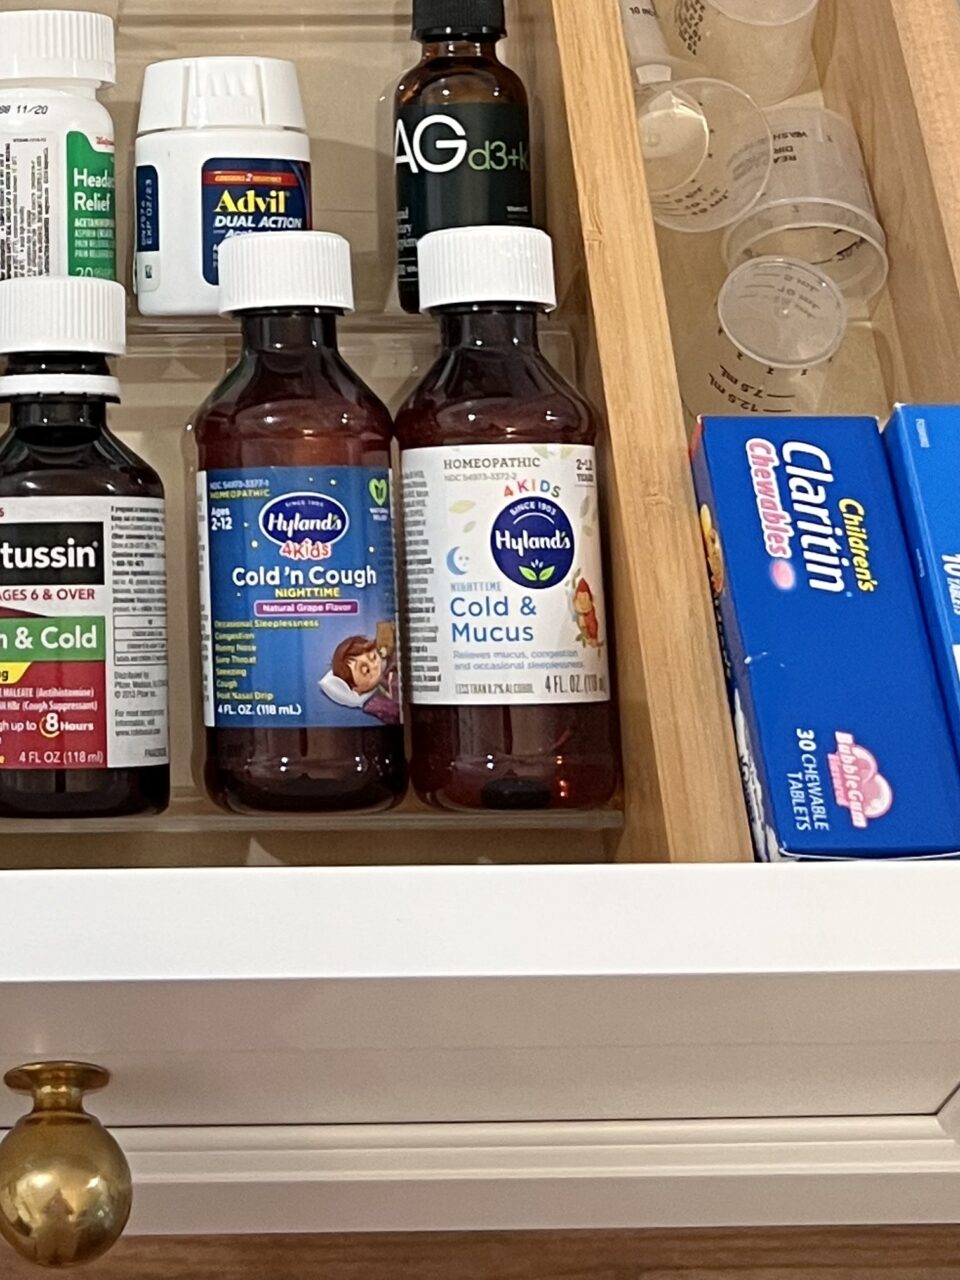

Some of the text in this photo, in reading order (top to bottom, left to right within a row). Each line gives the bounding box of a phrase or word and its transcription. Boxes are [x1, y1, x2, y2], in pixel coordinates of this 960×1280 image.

[16, 105, 48, 114] 11/20
[74, 193, 111, 211] Relief
[214, 190, 286, 213] Advil
[214, 216, 302, 228] DUAL ACTION
[708, 373, 758, 412] 12.5 mL
[741, 383, 763, 398] 7.5
[443, 458, 540, 469] HOMEOPATHIC
[747, 438, 793, 559] Chewables
[267, 513, 342, 537] Hyland's
[782, 440, 845, 594] Claritin
[496, 530, 571, 556] Hyland's
[839, 498, 877, 592] Children's
[232, 567, 280, 586] Cold
[309, 566, 376, 587] Cough
[31, 589, 39, 600] 6
[43, 589, 52, 600] &
[57, 589, 95, 600] OVER
[275, 588, 339, 598] NIGHTTIME
[262, 603, 351, 613] Natural Grape Flavor
[450, 596, 536, 617] Cold &
[254, 619, 319, 628] Sleeplessness
[452, 623, 534, 643] Mucus
[15, 627, 33, 649] &
[41, 627, 97, 649] Cold
[11, 722, 24, 733] up
[26, 721, 36, 731] to
[45, 713, 59, 731] 8
[61, 722, 94, 730] Hours
[19, 752, 26, 762] 4
[29, 752, 41, 762] FL
[44, 751, 61, 763] OZ
[63, 751, 86, 765] (118
[795, 728, 829, 829] 30 CHEWABLE
[786, 771, 810, 831] TABLETS
